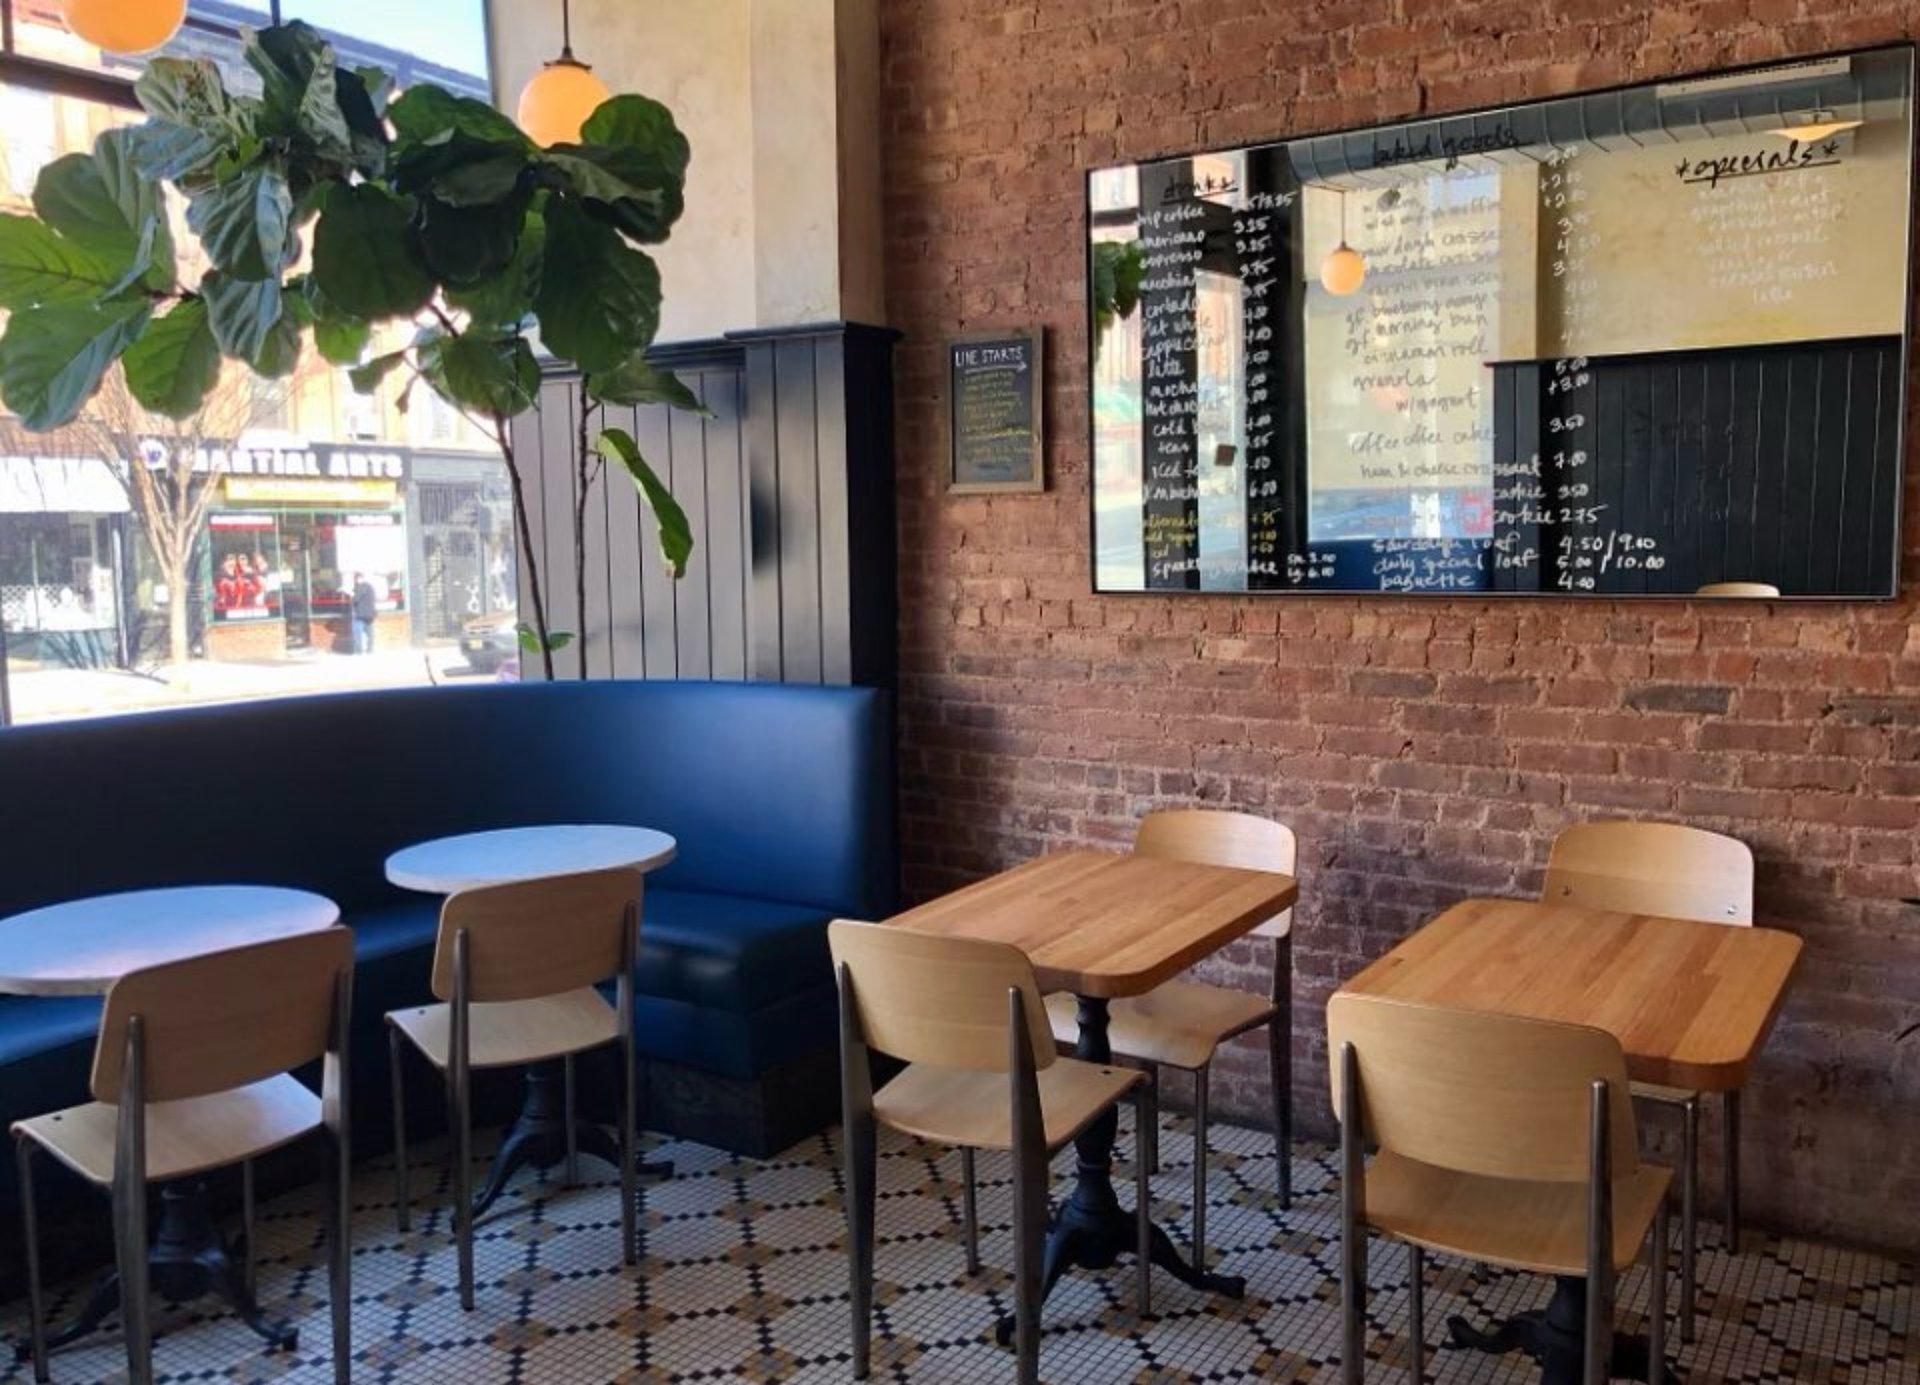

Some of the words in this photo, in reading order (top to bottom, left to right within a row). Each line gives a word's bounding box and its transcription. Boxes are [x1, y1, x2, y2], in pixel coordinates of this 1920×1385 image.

[1163, 204, 1205, 223] coffee
[1135, 229, 1205, 249] americano
[1138, 249, 1203, 269] espresso
[955, 350, 978, 367] LINE
[981, 346, 1023, 364] STARTS
[1149, 380, 1199, 398] mocha
[1353, 369, 1436, 391] granola
[1153, 419, 1187, 437] cold
[328, 452, 403, 477] ARTS
[1471, 530, 1521, 552] loaf
[1372, 552, 1417, 577] daily
[1421, 552, 1484, 575] special
[1496, 547, 1541, 569] loaf
[1377, 570, 1476, 593] baguette
